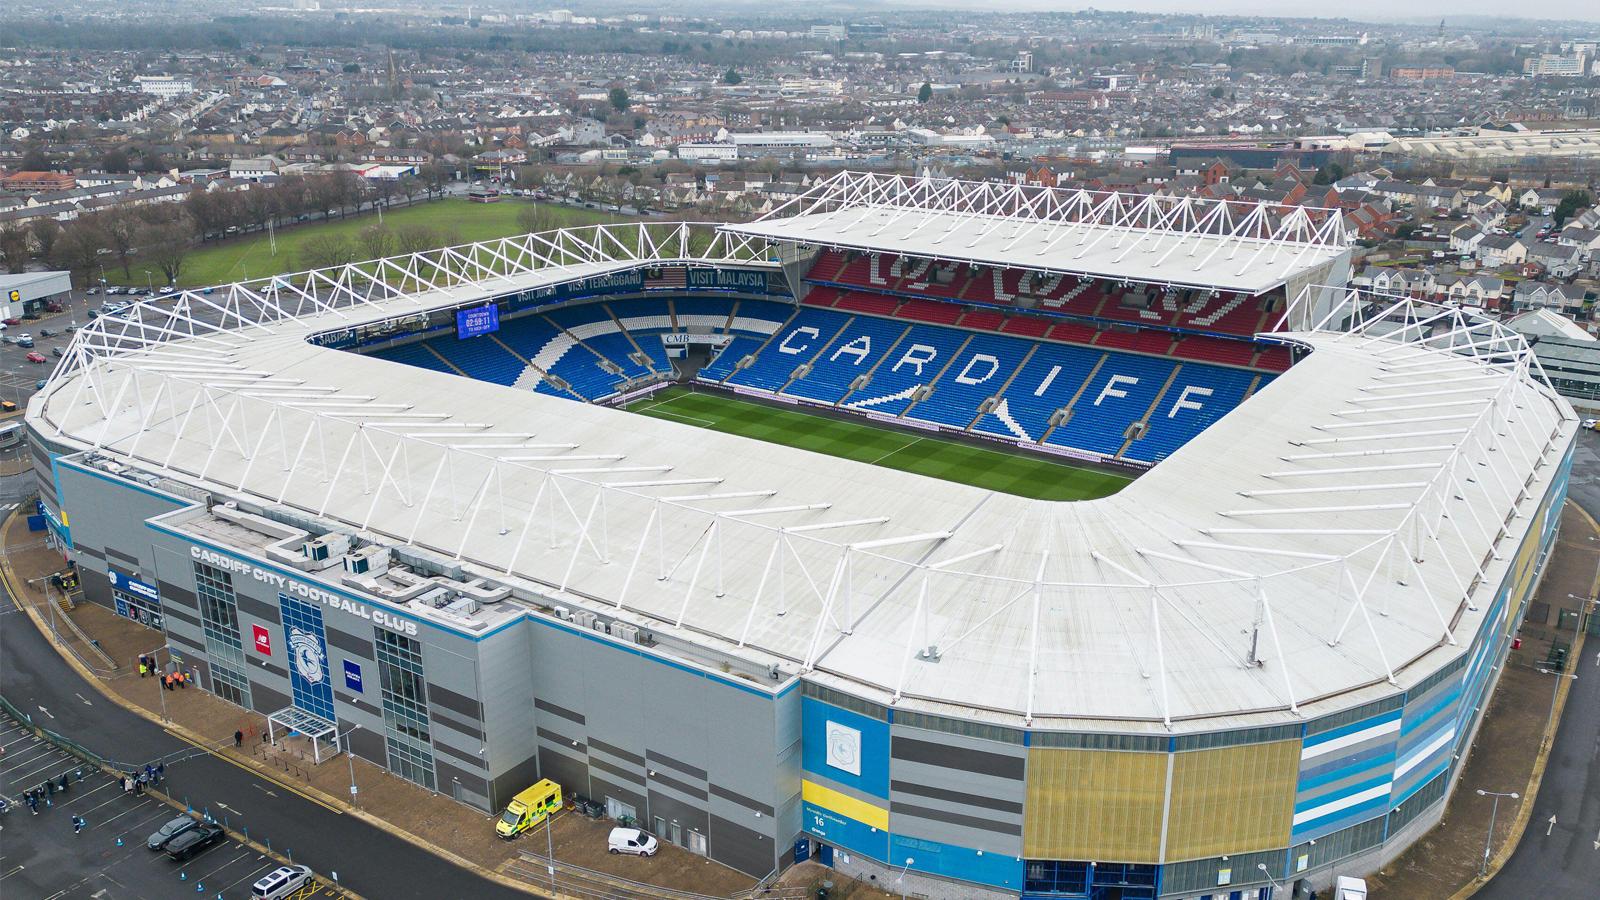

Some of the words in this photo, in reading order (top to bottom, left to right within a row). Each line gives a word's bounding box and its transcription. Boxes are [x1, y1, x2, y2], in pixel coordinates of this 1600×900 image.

[567, 279, 587, 292] VISIT
[588, 273, 642, 290] TERENGGANU
[689, 271, 715, 285] VISIT
[717, 271, 764, 287] MALAYSIA
[666, 333, 690, 344] CMB
[779, 325, 1213, 419] CARDIFF
[190, 546, 251, 575] CARDIFF
[252, 567, 286, 589] CITY
[288, 580, 371, 620] FOOTBALL
[372, 611, 418, 637] CLUB
[814, 815, 825, 827] 16
